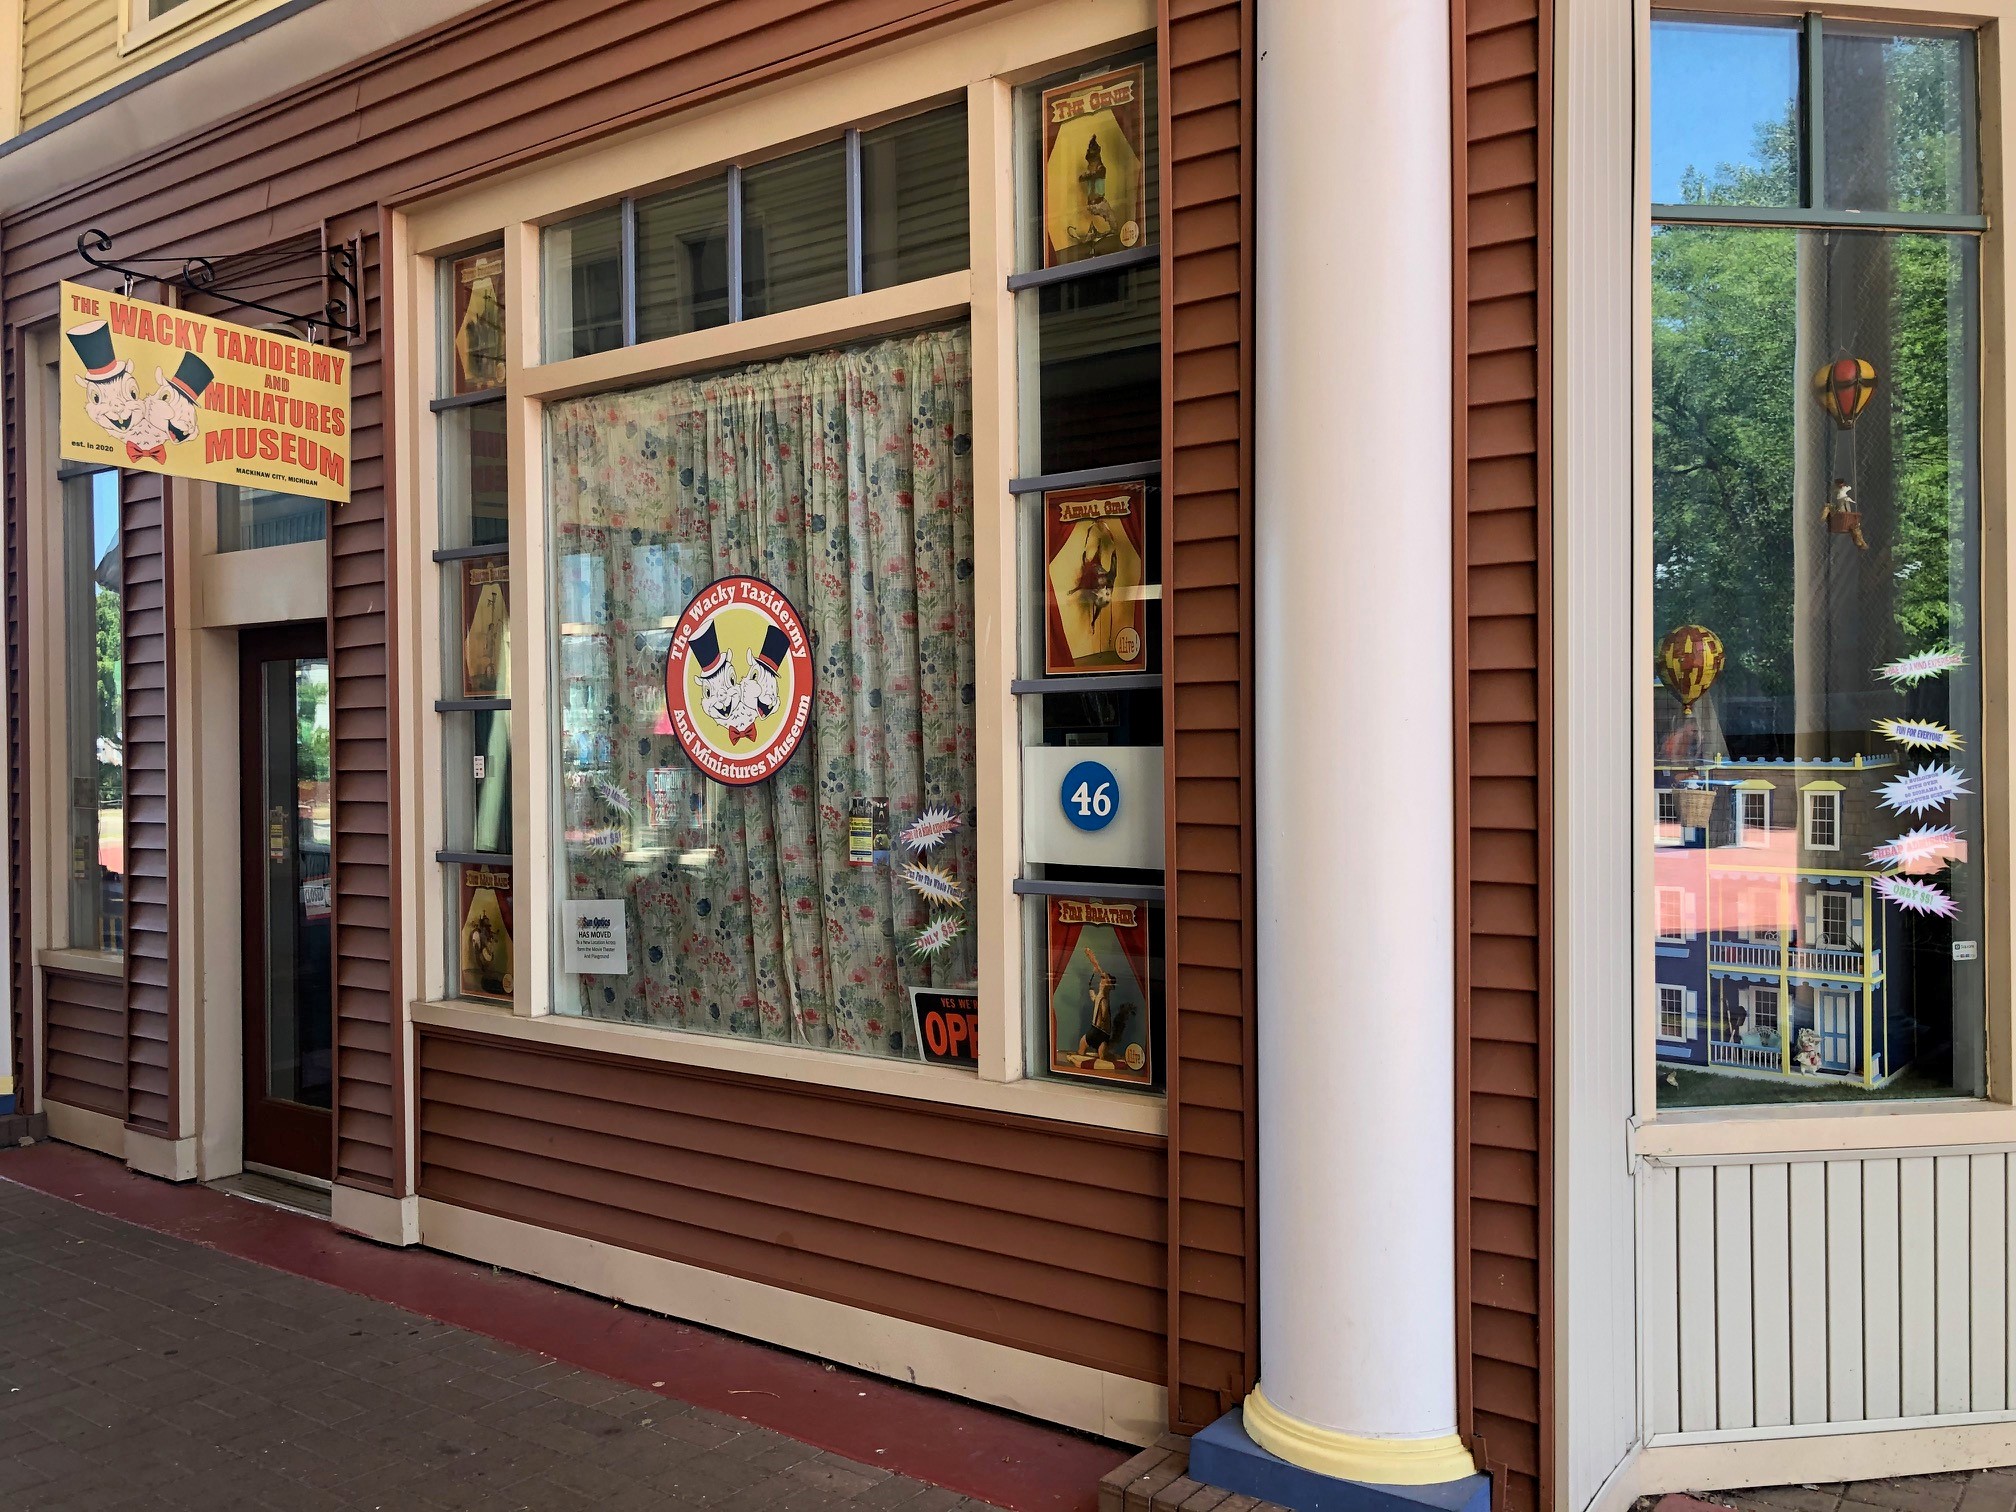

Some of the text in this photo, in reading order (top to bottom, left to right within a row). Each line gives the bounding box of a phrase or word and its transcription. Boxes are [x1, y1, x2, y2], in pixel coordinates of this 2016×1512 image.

[1056, 86, 1130, 119] THE GENIE
[71, 295, 345, 386] THE WACKY TAXIDERMY
[264, 374, 290, 393] AND
[204, 381, 345, 436] MINIATURES
[71, 440, 85, 449] est.
[95, 443, 114, 453] 2020
[205, 427, 344, 486] MUSEUM
[236, 467, 318, 486] MACKINAW CITY, MICHIGAN
[1063, 501, 1128, 519] AERIAL GIRL
[671, 582, 807, 660] The Wacky Taxidermy
[673, 695, 811, 779] And Miniatures Museum
[1896, 725, 1943, 743] FUN FOR EVERYONE!
[1071, 781, 1112, 817] 46
[1893, 884, 1919, 900] ONLY
[579, 931, 612, 939] HAS MOVED
[917, 931, 940, 949] ONLY
[940, 997, 978, 1010] YES WE'R
[925, 1011, 979, 1059] OPE
